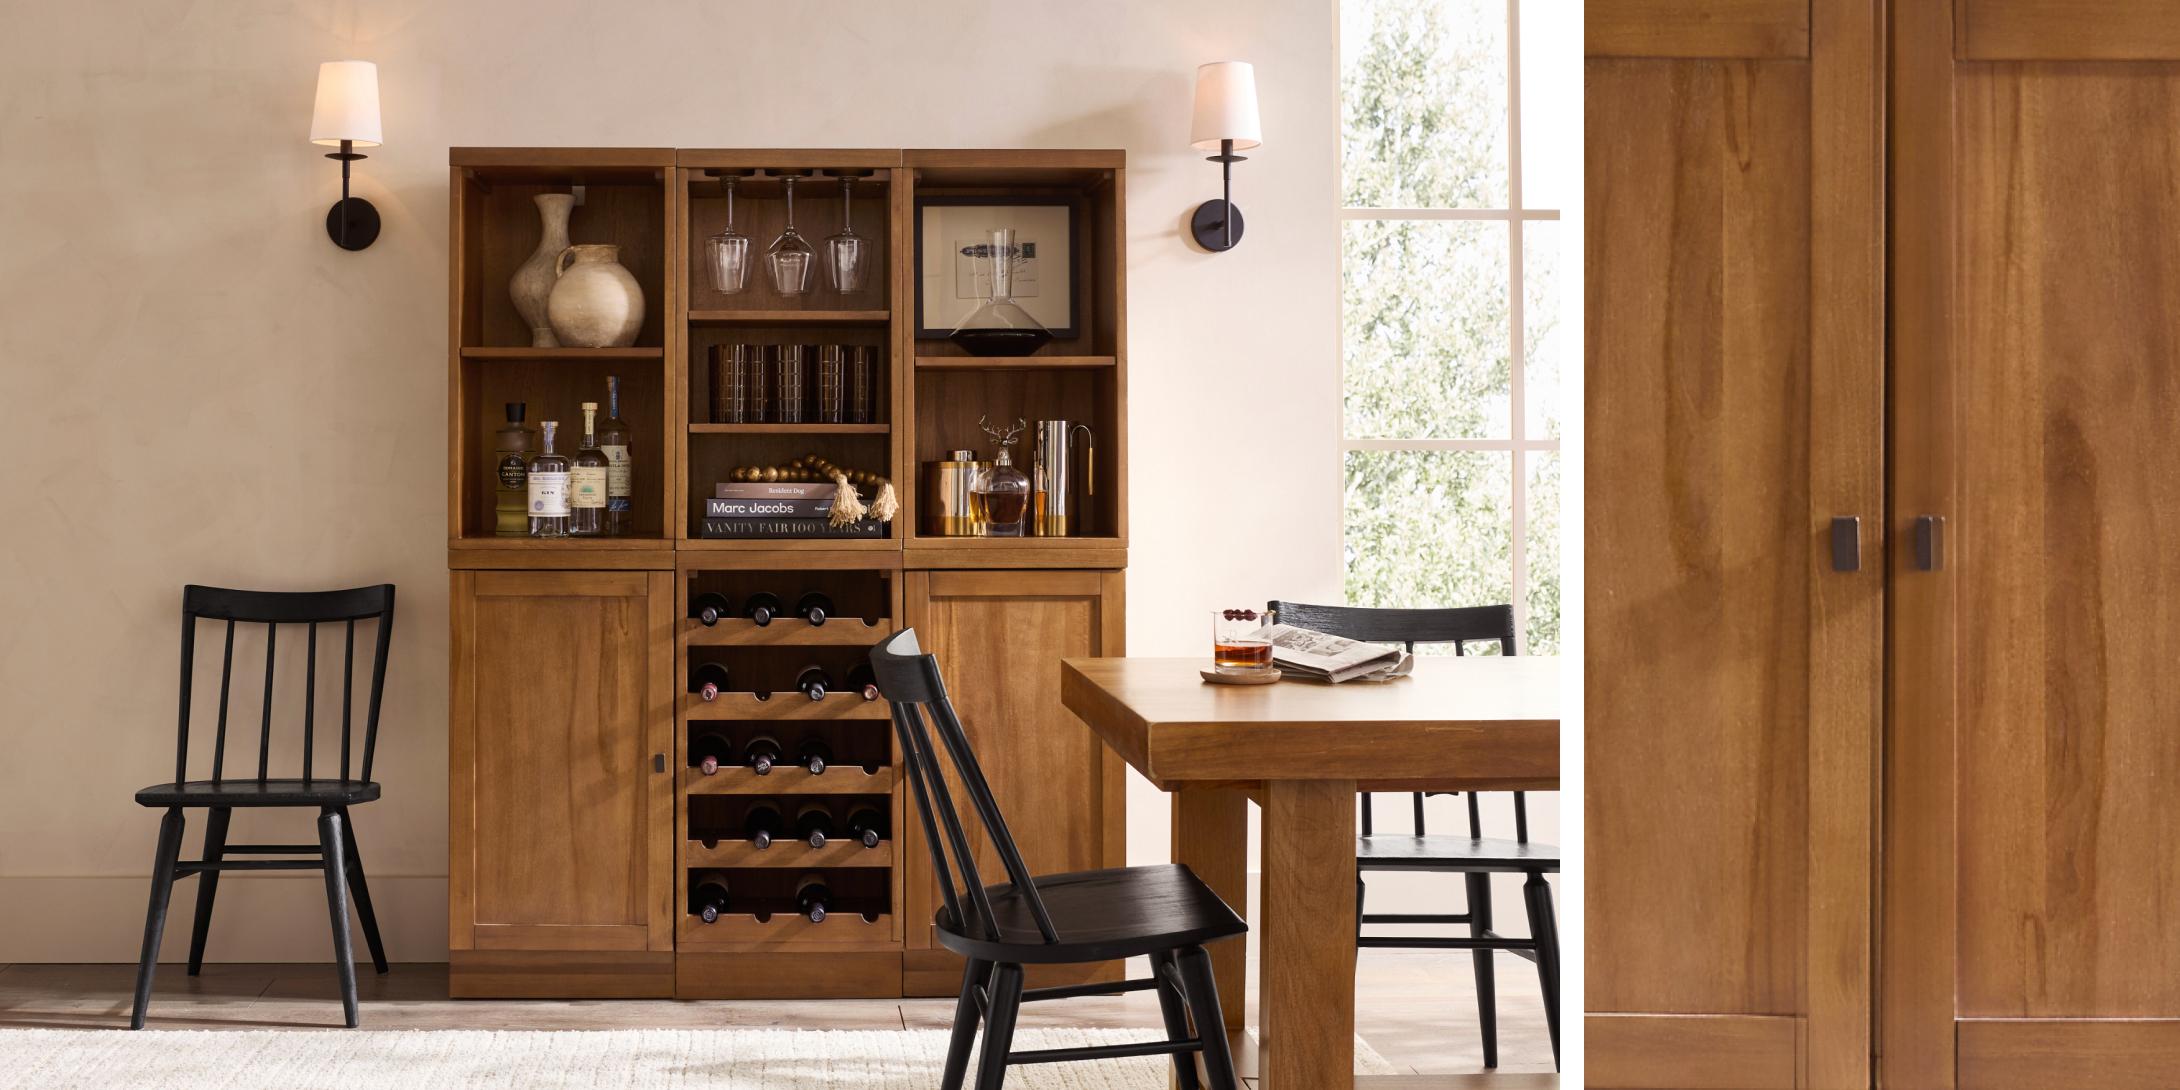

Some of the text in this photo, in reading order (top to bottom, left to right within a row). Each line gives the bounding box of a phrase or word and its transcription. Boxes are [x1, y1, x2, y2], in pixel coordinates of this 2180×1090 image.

[793, 487, 805, 495] Dog
[713, 502, 746, 513] Marc
[749, 502, 794, 513] Jacobs
[707, 522, 753, 533] VANITY
[760, 522, 788, 533] FAIR
[792, 522, 816, 533] 100
